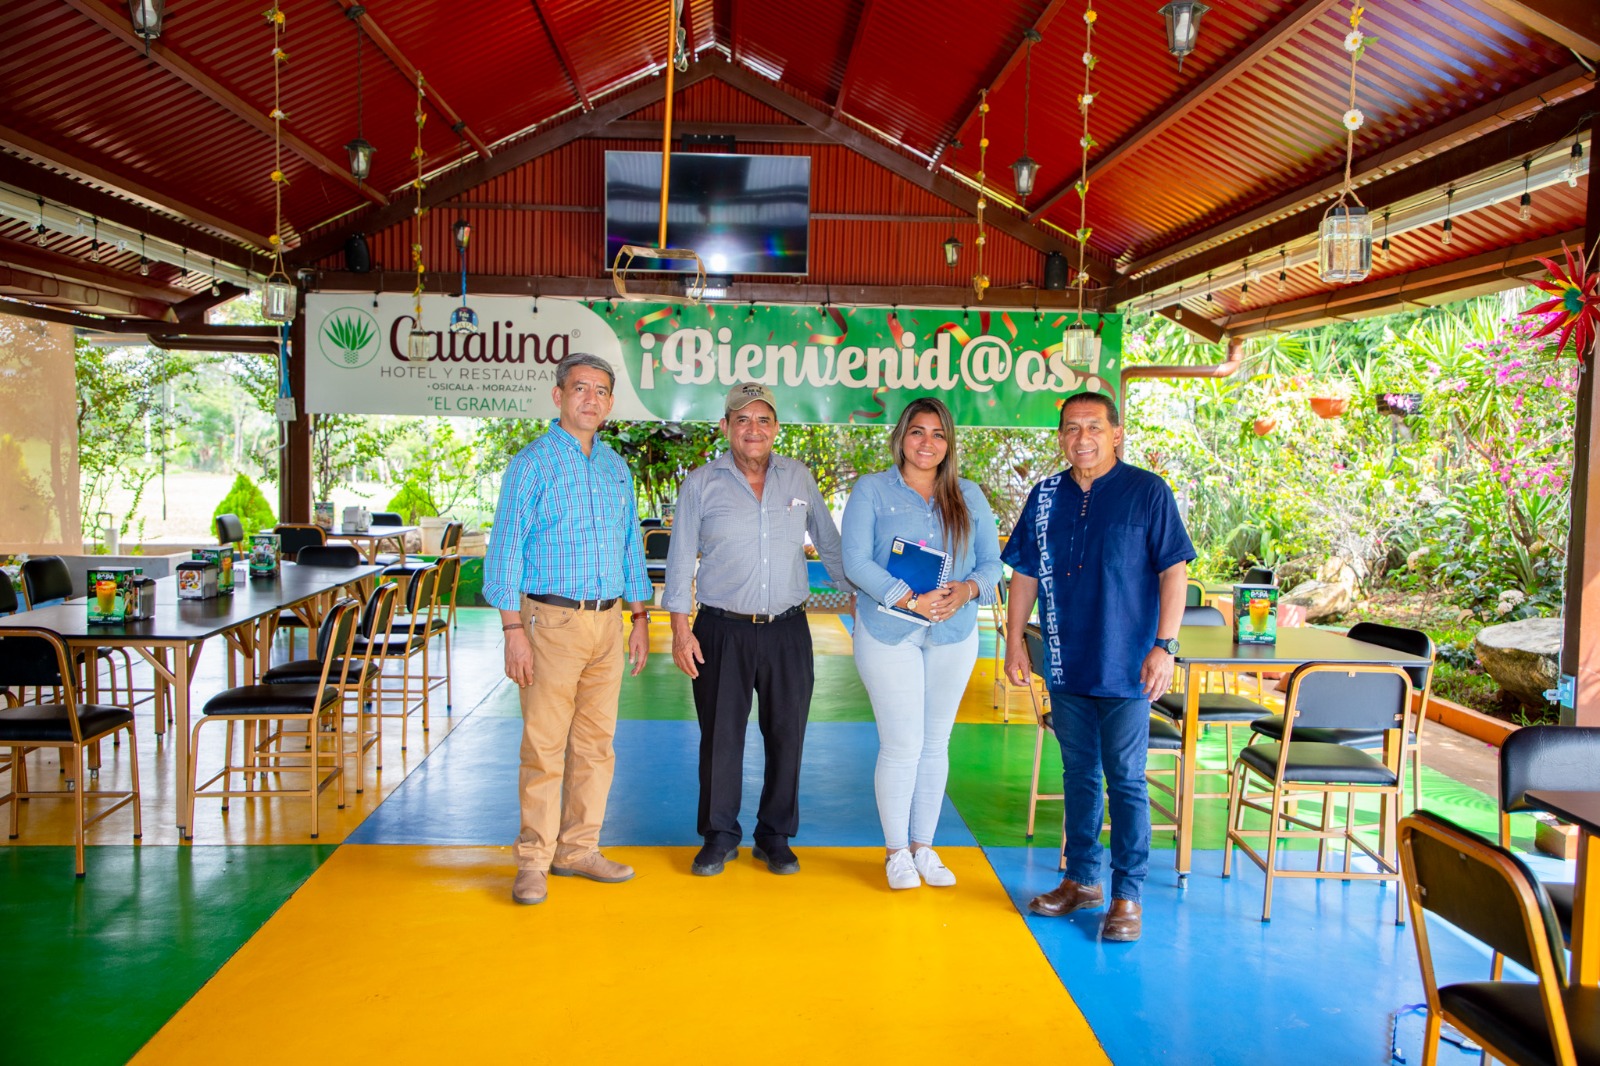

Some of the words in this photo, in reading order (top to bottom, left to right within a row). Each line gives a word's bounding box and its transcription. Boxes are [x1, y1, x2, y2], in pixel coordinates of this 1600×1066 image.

[390, 315, 569, 364] Catalina
[381, 366, 437, 379] HOTEL
[443, 367, 453, 379] Y
[460, 367, 557, 381] RESTAURAN
[432, 382, 474, 391] OSICALA
[482, 382, 532, 392] MORAZÁN
